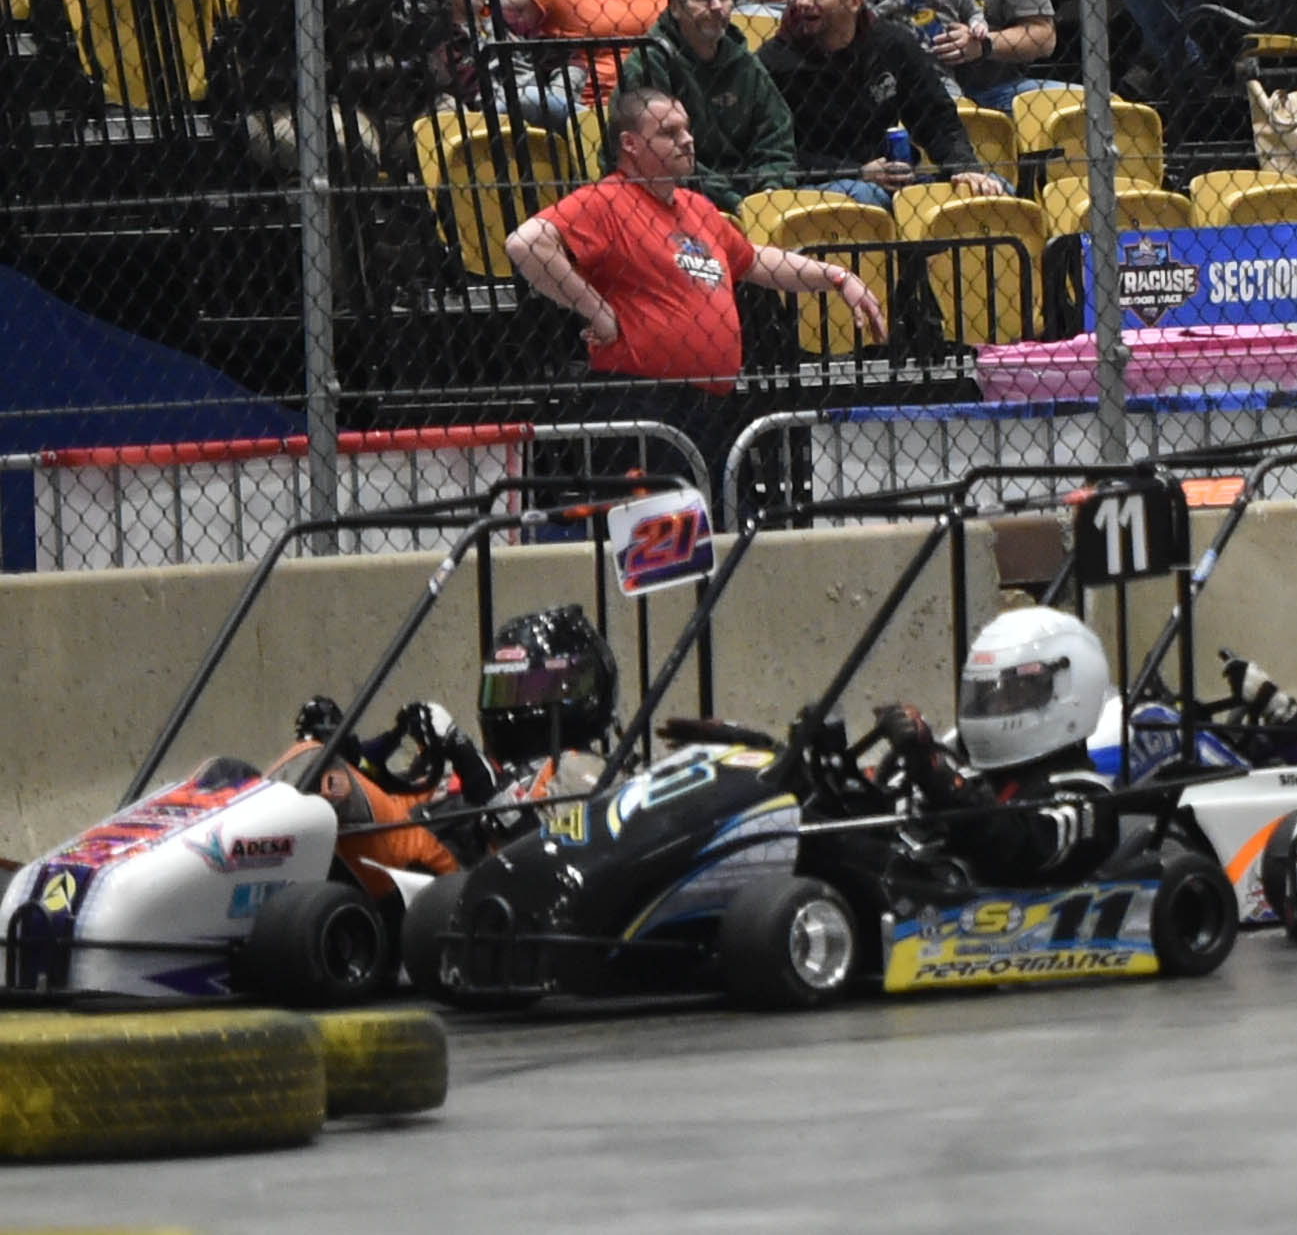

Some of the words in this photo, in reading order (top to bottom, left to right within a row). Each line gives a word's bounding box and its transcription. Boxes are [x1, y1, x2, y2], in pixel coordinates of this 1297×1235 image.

[1119, 267, 1196, 294] RACUSE
[1119, 296, 1155, 306] NDOOR
[622, 508, 700, 576] 21
[1093, 494, 1148, 575] 11
[230, 837, 293, 857] ADESA
[1050, 889, 1140, 942] 11
